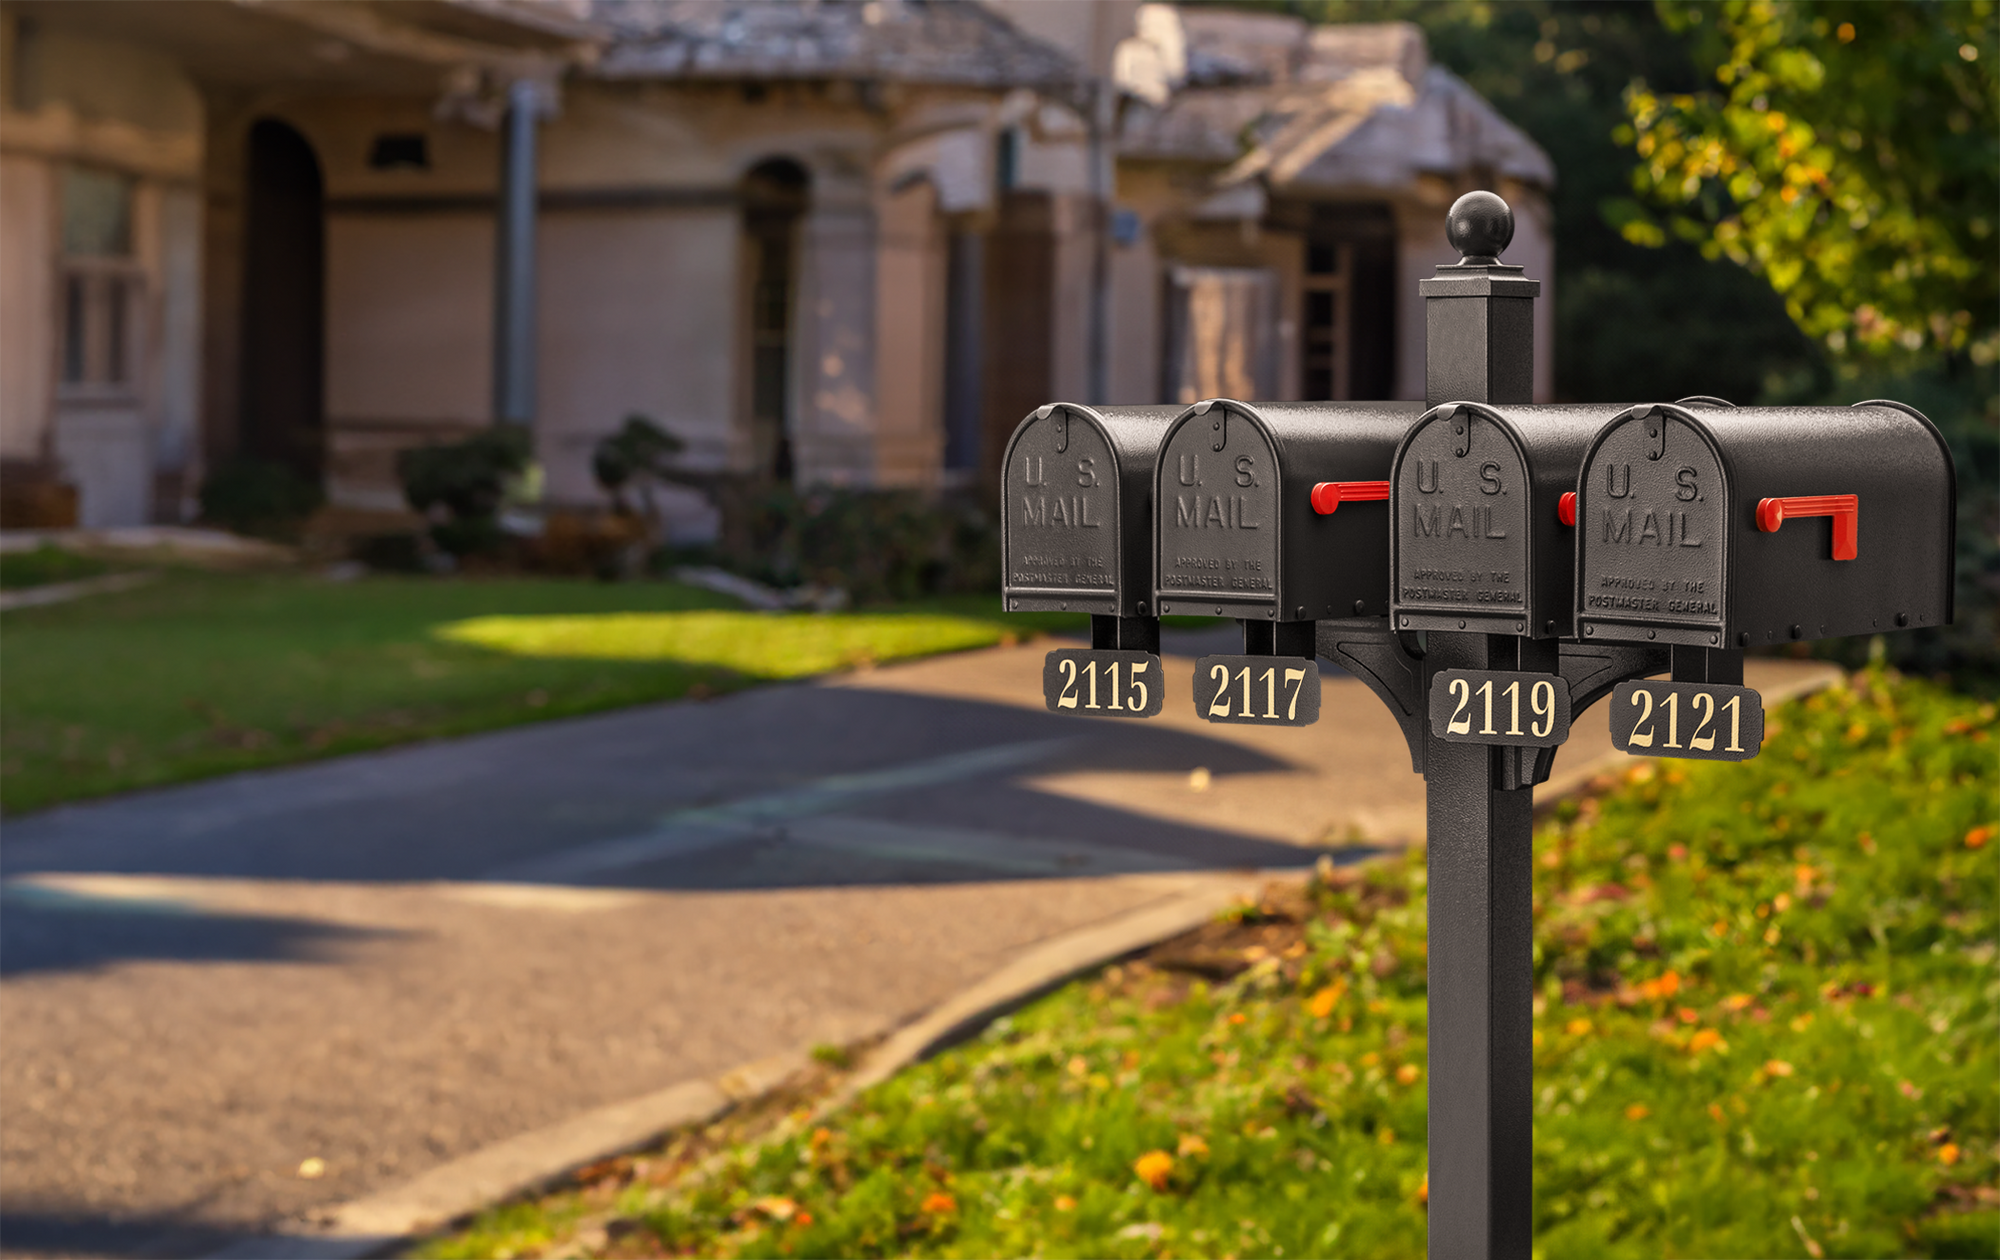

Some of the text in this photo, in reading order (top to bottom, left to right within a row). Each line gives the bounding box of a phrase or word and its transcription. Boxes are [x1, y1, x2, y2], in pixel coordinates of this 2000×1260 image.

[1024, 456, 1100, 488] U. S.
[1179, 454, 1260, 488] U. S.
[1416, 459, 1508, 496] U. S.
[1606, 463, 1704, 502] U. S.
[1022, 496, 1101, 528] MAIL
[1176, 496, 1260, 530] MAIL
[1413, 504, 1507, 540] MAIL
[1601, 509, 1702, 548] MAIL
[1175, 557, 1262, 571] APPROVED BY THE
[1413, 568, 1464, 582] APPROVED
[1490, 570, 1510, 584] THE
[1165, 574, 1273, 590] POSTMASTER GENERAL
[1402, 586, 1523, 603] POSTMASTER GENERAL
[1601, 575, 1655, 591] APPROVED
[1684, 580, 1705, 594] THE
[1588, 594, 1718, 615] POSTMASTER GENERAL
[1058, 659, 1148, 711] 2115
[1209, 665, 1306, 720] 2117
[1447, 679, 1555, 737] 2119
[1628, 689, 1745, 753] 2121
